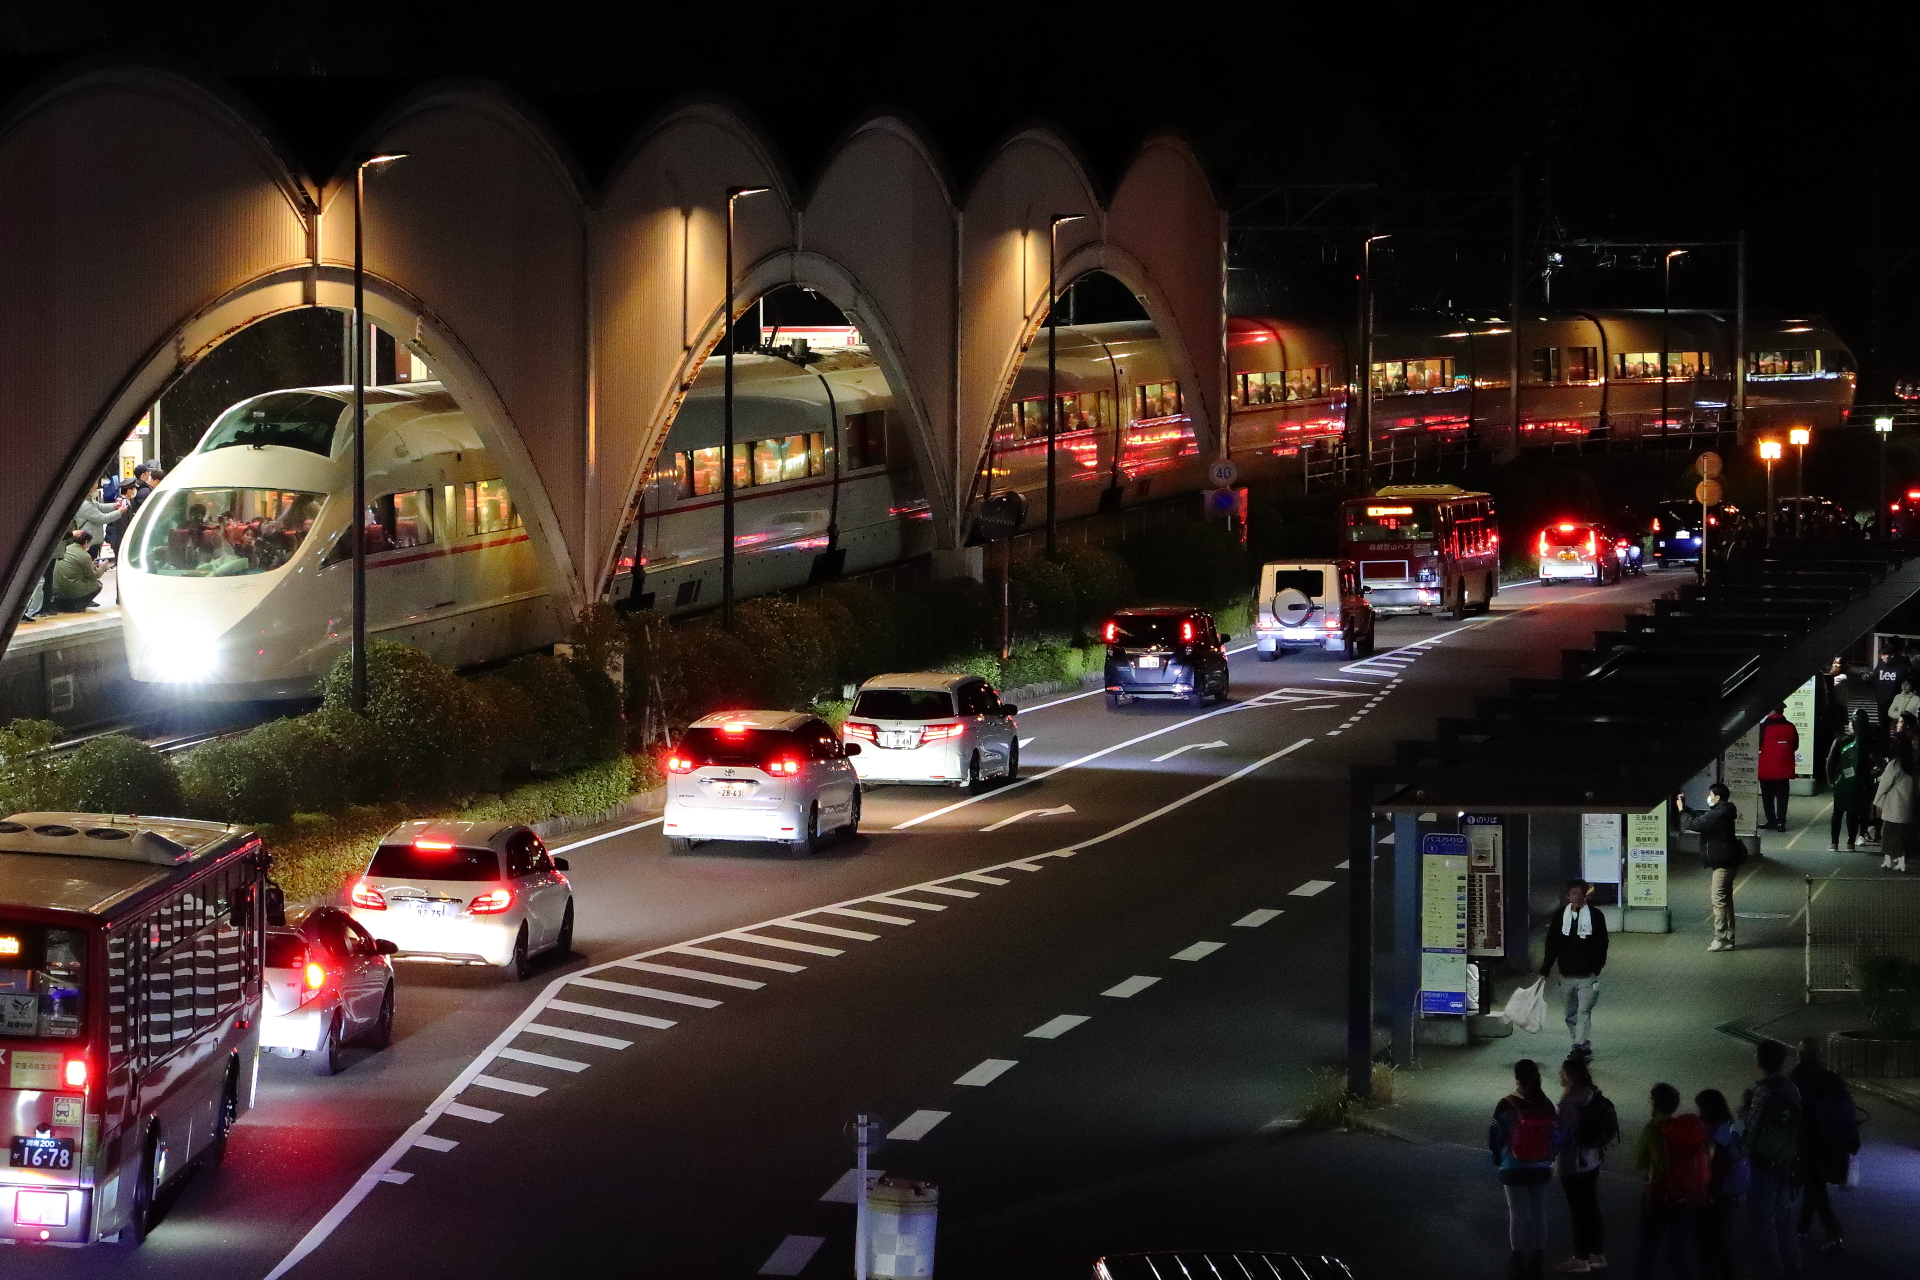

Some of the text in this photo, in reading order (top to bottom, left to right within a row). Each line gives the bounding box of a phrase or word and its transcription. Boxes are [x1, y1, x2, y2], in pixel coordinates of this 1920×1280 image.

[1216, 466, 1231, 479] 40
[1879, 670, 1897, 681] Lee
[1476, 816, 1498, 824] のりば
[23, 1147, 70, 1168] 16-78
